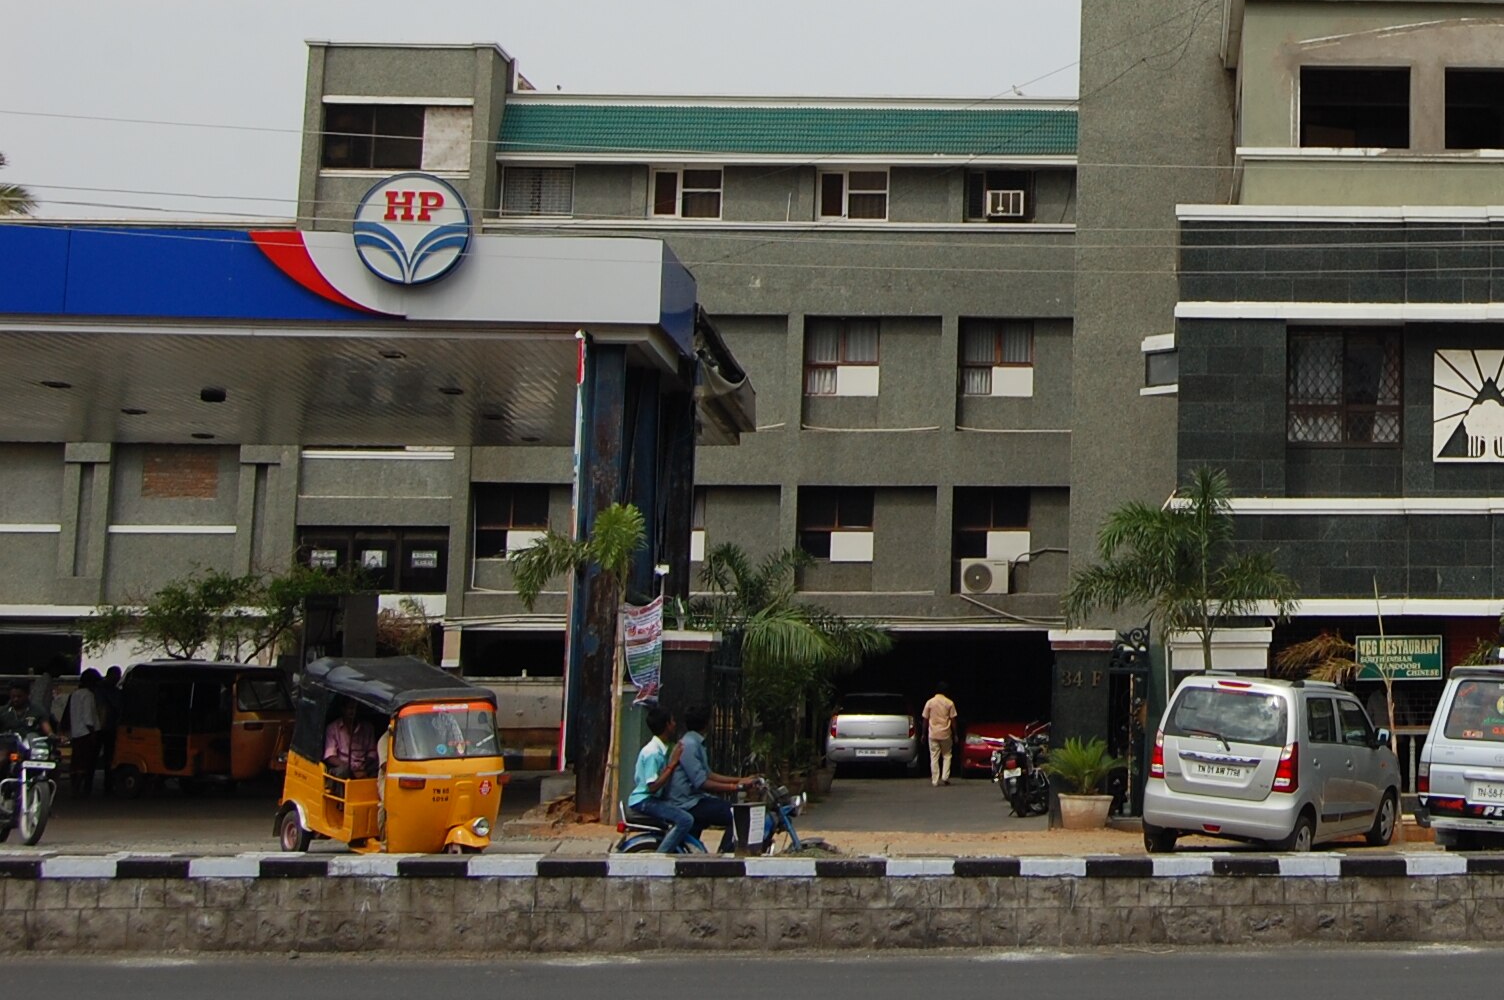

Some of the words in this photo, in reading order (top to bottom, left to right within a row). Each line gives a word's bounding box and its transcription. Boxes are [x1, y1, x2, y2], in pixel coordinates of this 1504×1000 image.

[384, 191, 444, 221] HP
[1360, 640, 1377, 655] VEG
[1380, 639, 1440, 655] RESTAURANT
[1061, 670, 1083, 687] 34
[1092, 670, 1103, 686] F
[1406, 669, 1440, 677] CHINESE
